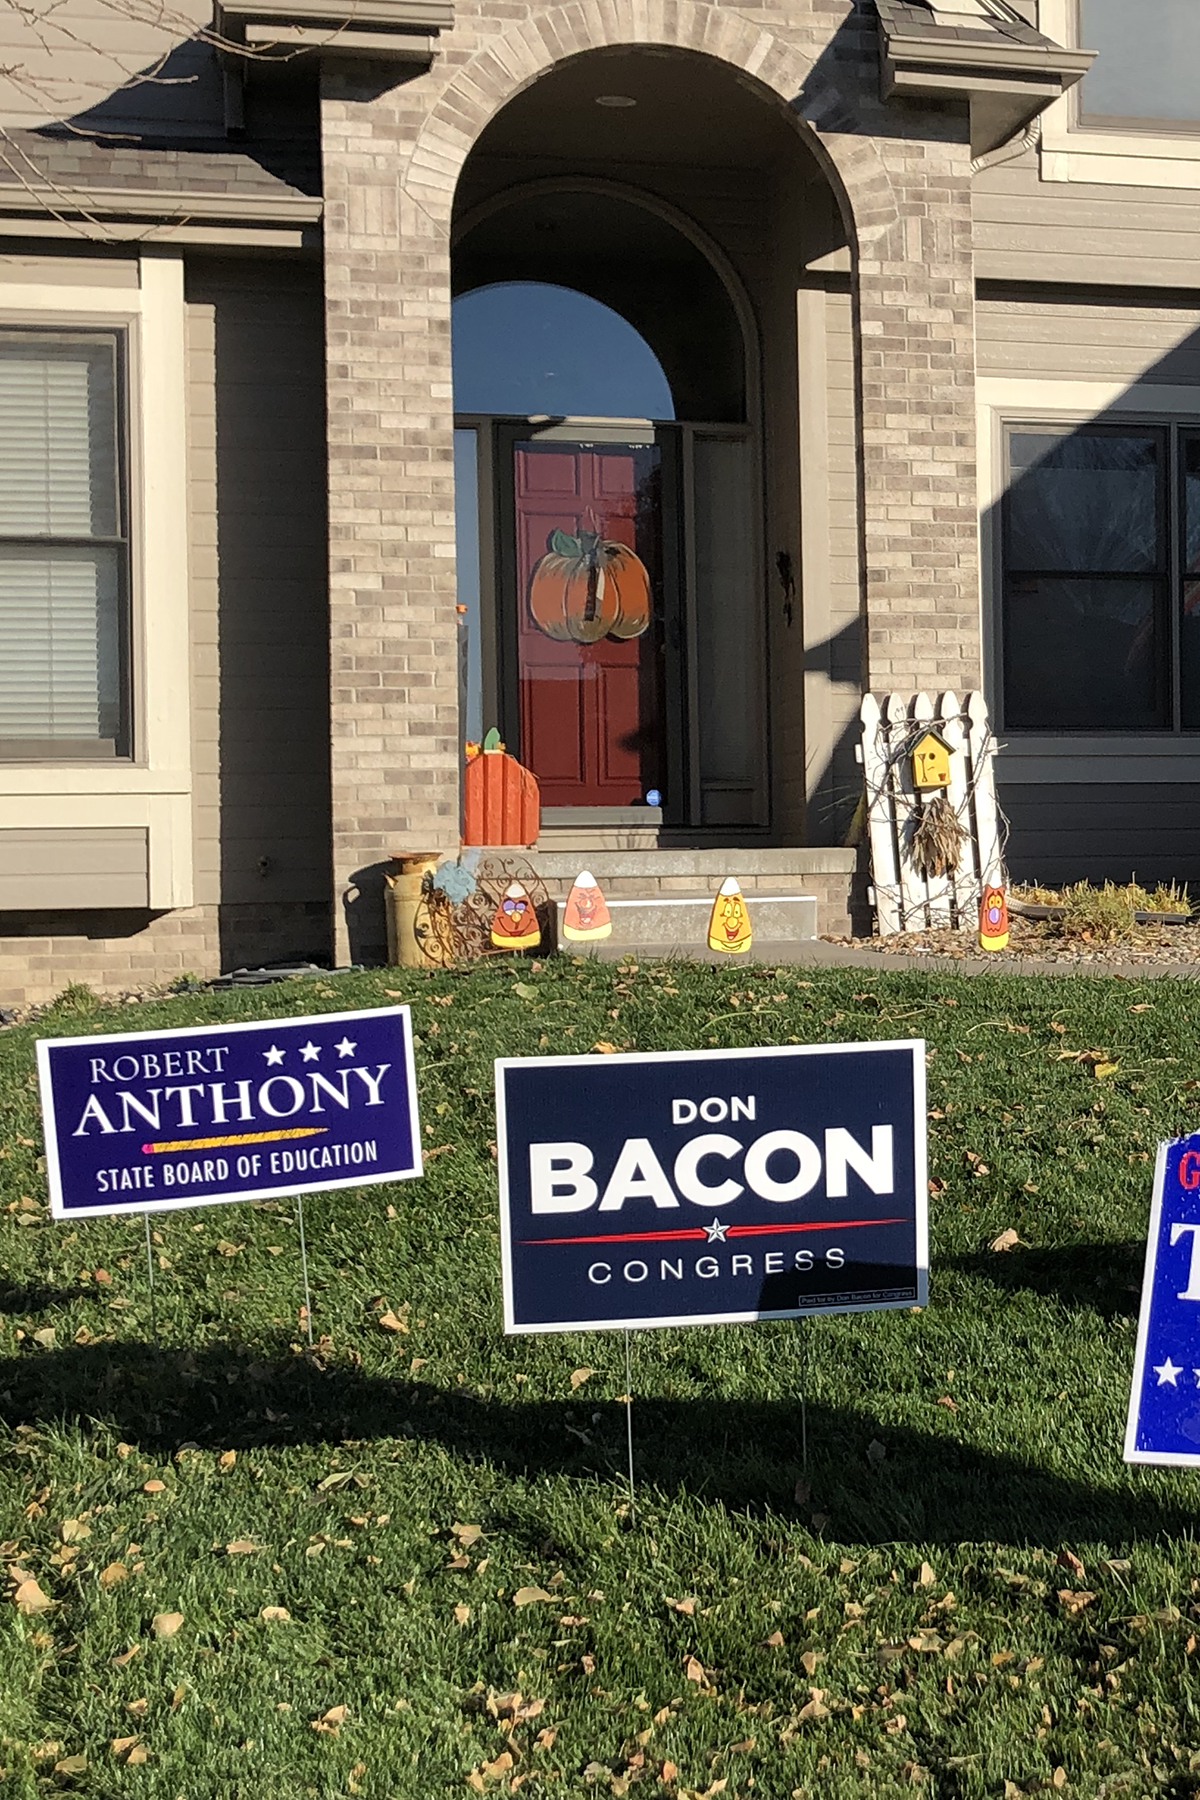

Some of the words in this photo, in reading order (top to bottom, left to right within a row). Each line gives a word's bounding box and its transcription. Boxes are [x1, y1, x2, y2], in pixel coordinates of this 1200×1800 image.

[89, 1047, 229, 1083] ROBERT
[71, 1063, 392, 1137] ANTHONY
[672, 1095, 757, 1125] DON
[96, 1165, 155, 1193] STATE
[163, 1159, 229, 1187] BOARD
[237, 1155, 262, 1179] OF
[270, 1140, 378, 1175] EDUCATION
[529, 1124, 895, 1215] BACON
[588, 1247, 846, 1285] CONGRESS
